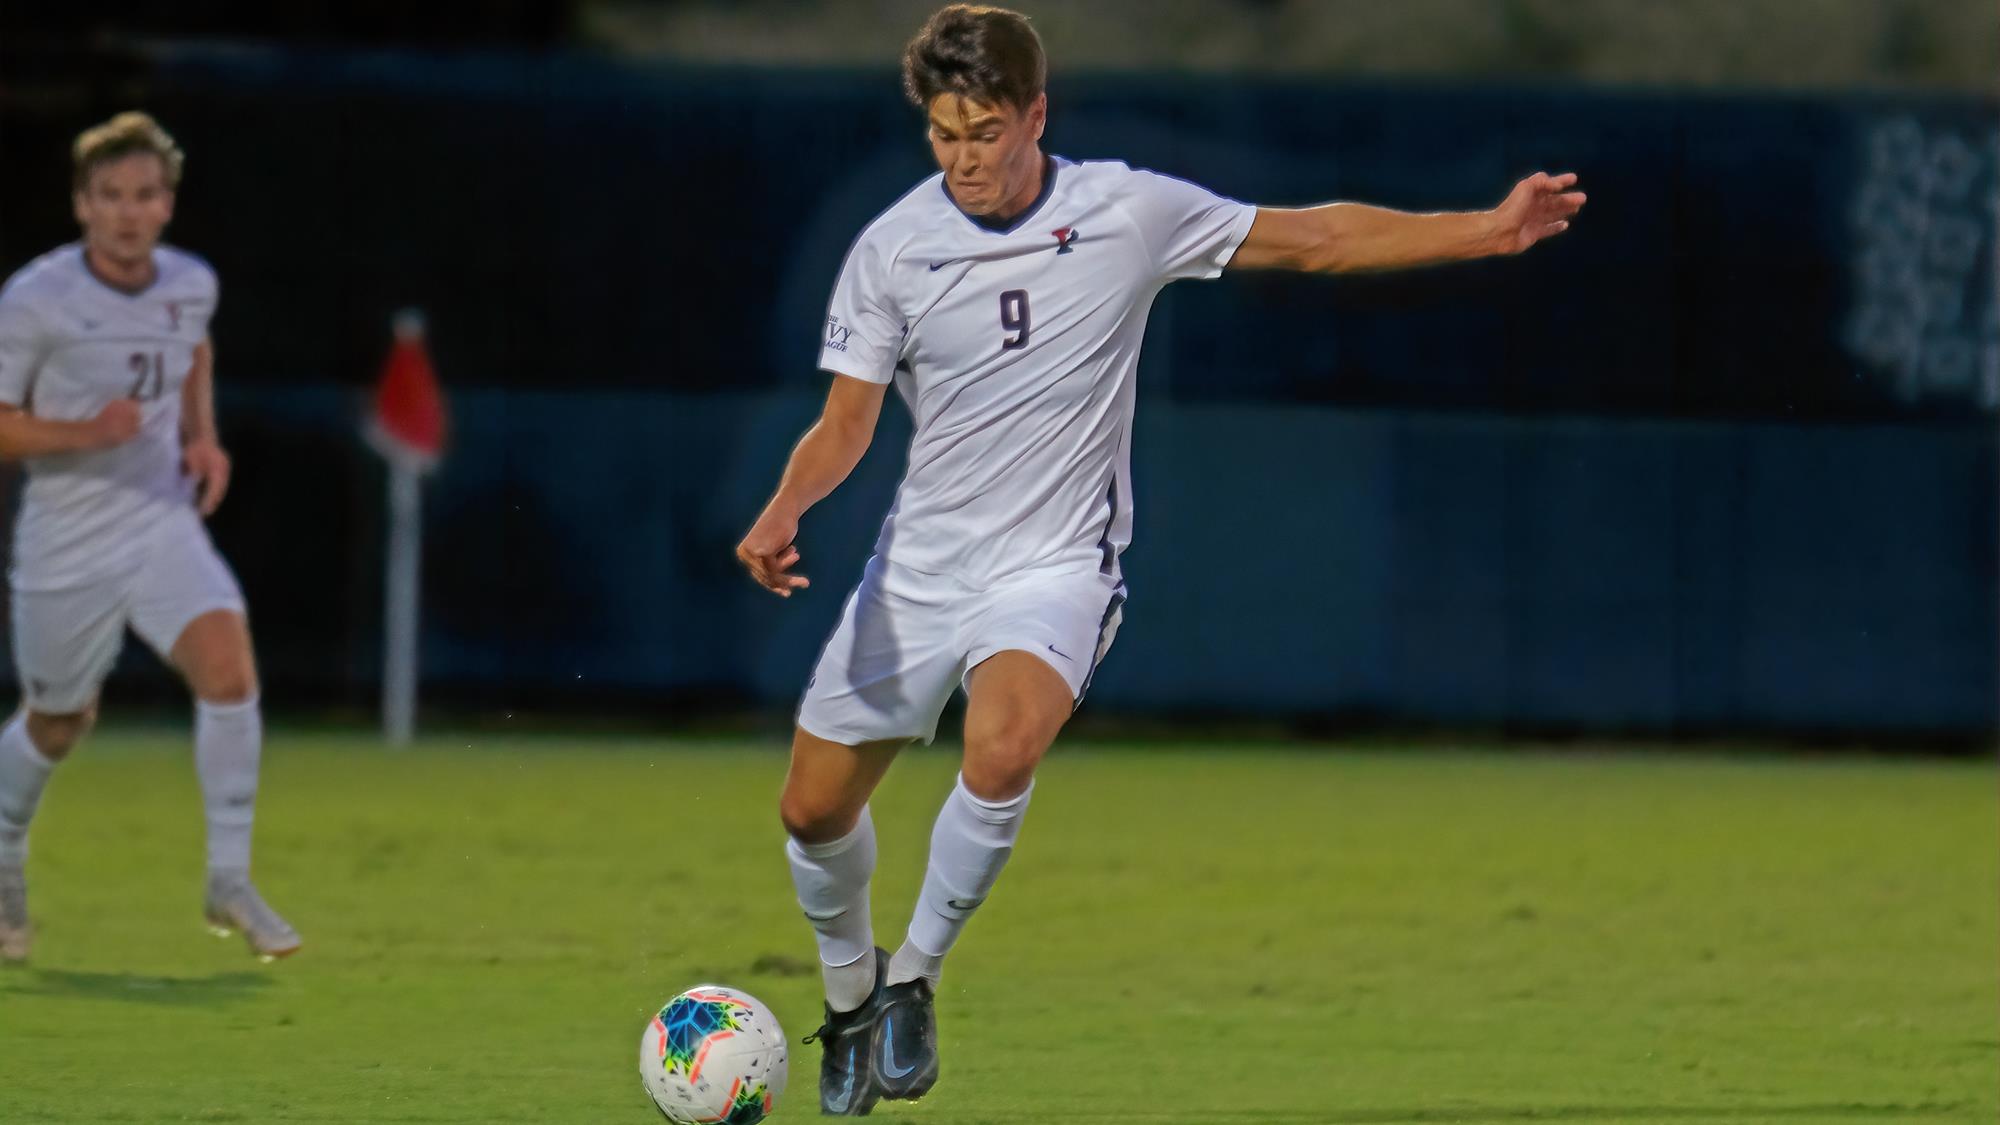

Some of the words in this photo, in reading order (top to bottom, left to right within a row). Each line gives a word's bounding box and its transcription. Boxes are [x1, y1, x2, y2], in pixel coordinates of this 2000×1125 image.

[827, 321, 852, 344] VY
[1000, 289, 1031, 350] 9
[825, 340, 848, 353] AGUE
[129, 351, 164, 402] 21
